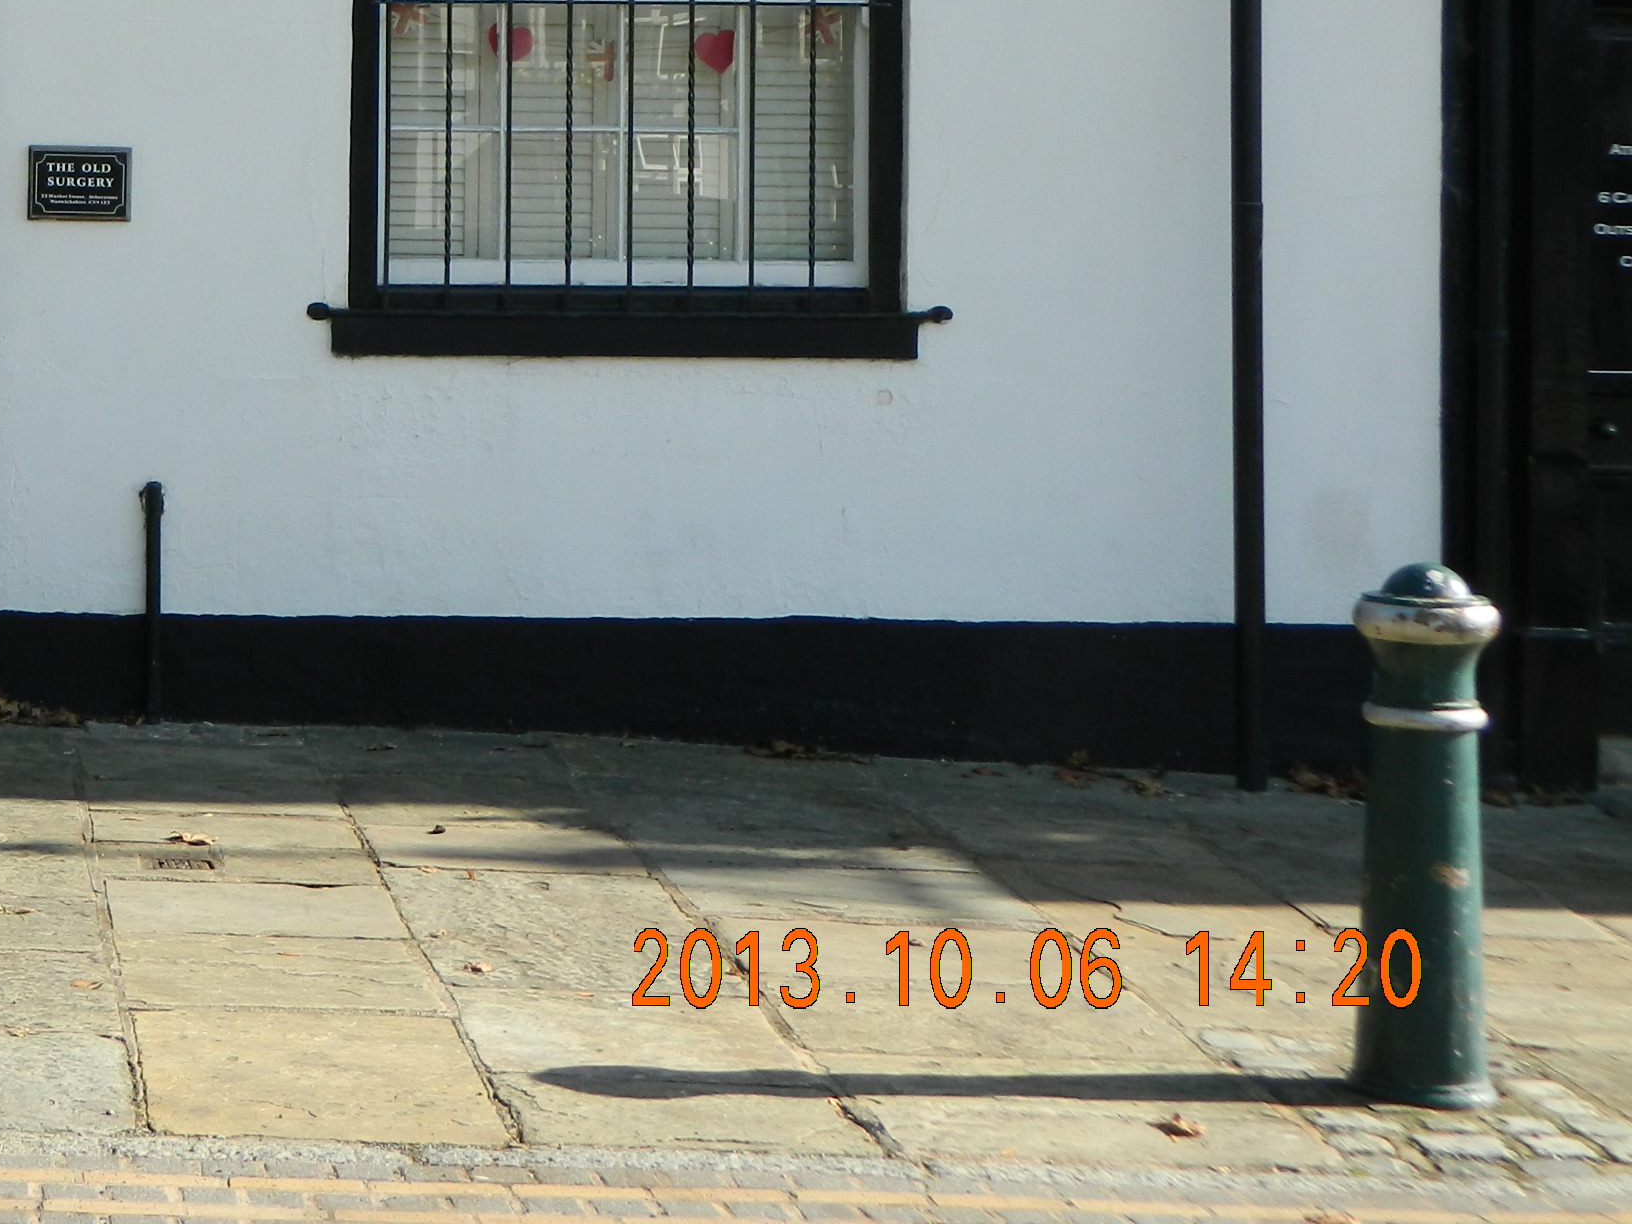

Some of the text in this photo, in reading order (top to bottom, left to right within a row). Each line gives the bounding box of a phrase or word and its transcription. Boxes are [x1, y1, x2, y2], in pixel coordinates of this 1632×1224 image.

[47, 162, 111, 173] THE OLD
[47, 176, 114, 188] SURGERY
